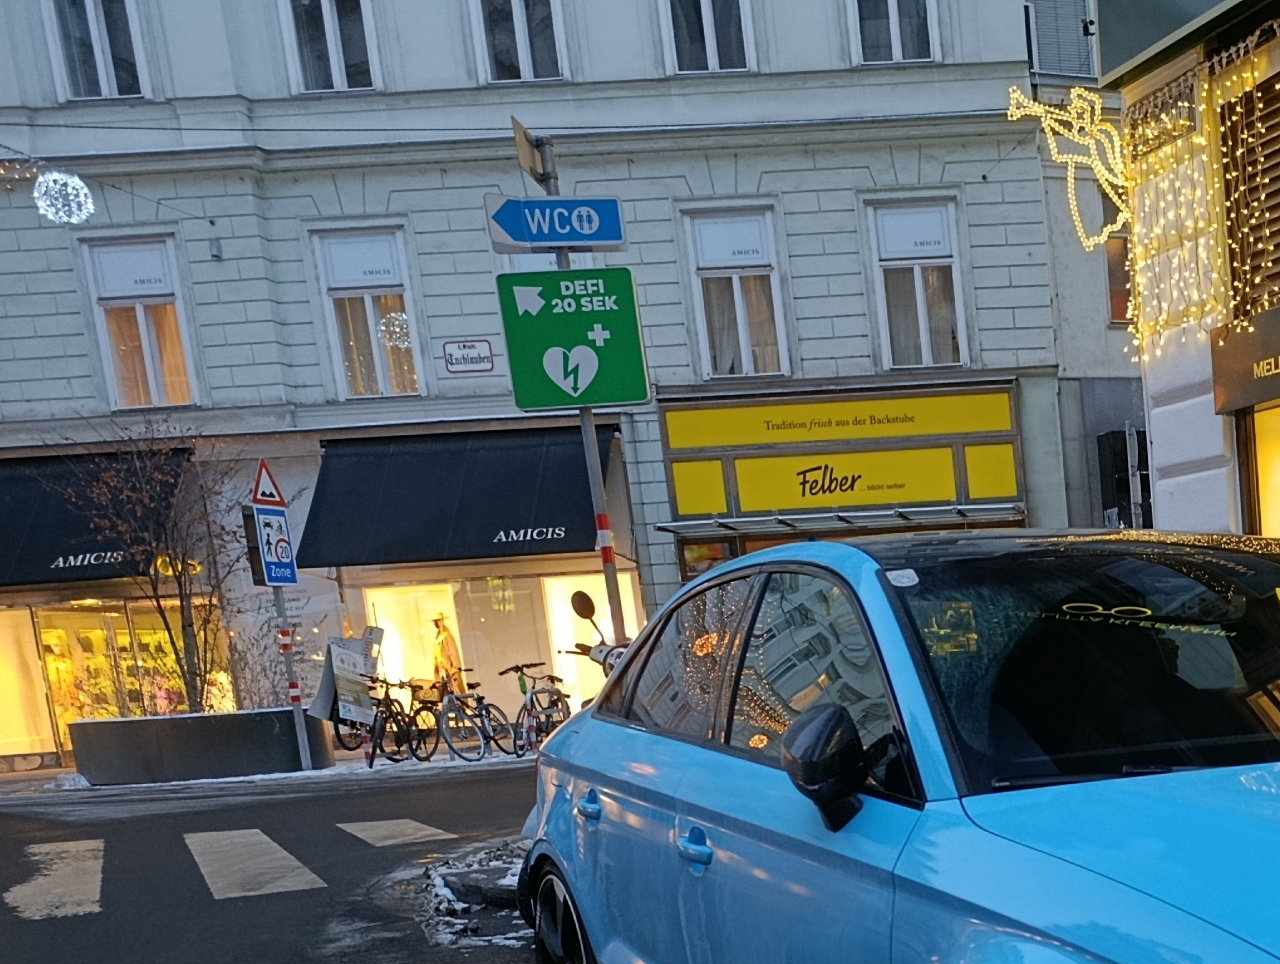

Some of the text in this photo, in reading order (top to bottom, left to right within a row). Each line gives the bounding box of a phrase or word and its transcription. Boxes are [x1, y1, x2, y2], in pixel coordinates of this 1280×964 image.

[524, 208, 571, 235] WC
[560, 279, 605, 296] DEFI
[551, 295, 619, 313] 20 SEK
[764, 413, 916, 432] Tradition frisch aus der Backstube
[796, 463, 862, 498] Felber
[886, 482, 906, 490] selber
[493, 526, 566, 543] AMICIS
[50, 551, 124, 568] AMICIS
[279, 545, 290, 560] 20
[270, 565, 292, 578] Zone
